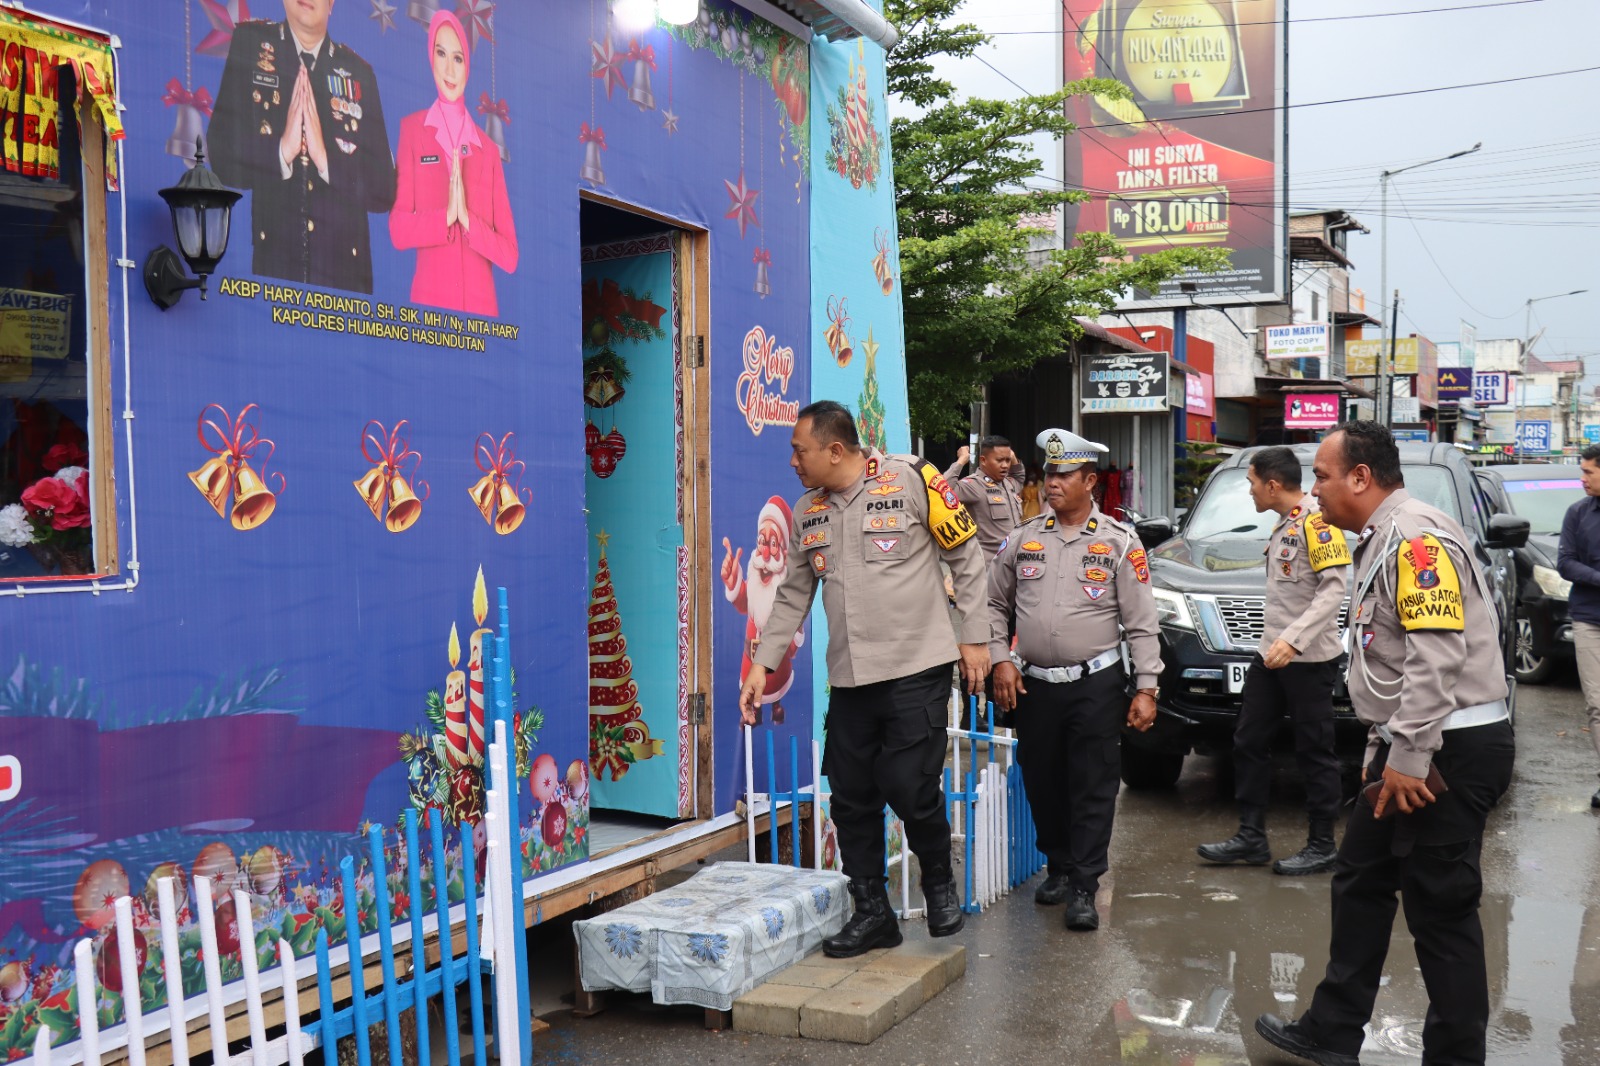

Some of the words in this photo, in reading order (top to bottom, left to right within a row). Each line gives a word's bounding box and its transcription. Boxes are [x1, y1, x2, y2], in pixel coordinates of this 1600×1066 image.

[1128, 36, 1226, 64] NUSANTARA
[1154, 68, 1202, 79] RAYA
[1128, 147, 1150, 167] INI
[1154, 143, 1204, 165] SURYA
[1116, 168, 1164, 189] TANPA
[1168, 164, 1218, 185] FILTER
[1114, 208, 1130, 229] Rp
[1131, 197, 1219, 234] 18.000
[220, 278, 261, 298] AKBP
[264, 284, 303, 305] HARY
[305, 292, 374, 318] ARDIANTO,
[377, 303, 397, 320] SH.
[400, 308, 421, 324] SIK.
[424, 311, 441, 327] MH
[450, 316, 465, 333] Ny.
[467, 319, 490, 335] NITA
[492, 323, 519, 340] HARY
[273, 307, 345, 332] KAPOLRES
[348, 318, 409, 341] HUMBANG
[412, 328, 485, 351] HASUNDUTAN
[1268, 328, 1290, 337] TOKO
[1292, 325, 1325, 336] MARTIN
[1297, 337, 1319, 345] COPY
[1348, 342, 1414, 358] CENAL
[743, 325, 794, 395] Merry
[1089, 370, 1139, 382] BARBER
[1475, 375, 1500, 387] TER
[736, 371, 799, 436] Christmas
[1474, 389, 1498, 401] SEL
[1090, 398, 1156, 410] GENTLEMAN
[866, 499, 904, 512] POLRI
[802, 514, 830, 531] HARY.A
[936, 521, 961, 545] KA
[1082, 555, 1115, 568] POLRI
[1400, 591, 1427, 613] KASUB
[1405, 603, 1461, 621] KAWAL
